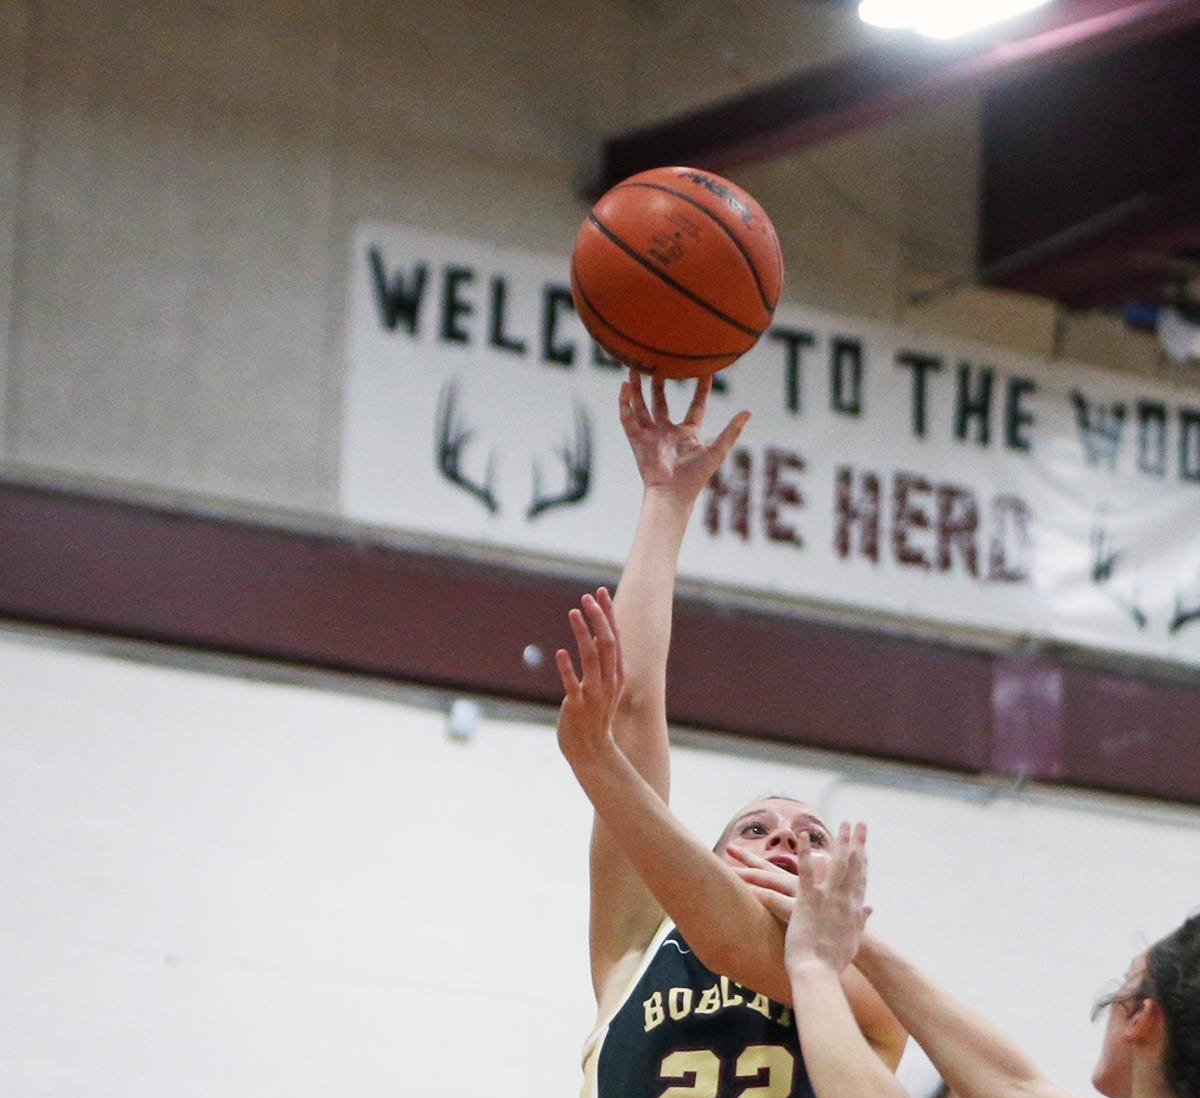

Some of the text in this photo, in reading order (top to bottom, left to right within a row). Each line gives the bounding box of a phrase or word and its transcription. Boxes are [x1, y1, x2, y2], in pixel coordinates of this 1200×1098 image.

[768, 325, 866, 418] TO
[895, 350, 1037, 453] THE
[832, 463, 1029, 583] HERD
